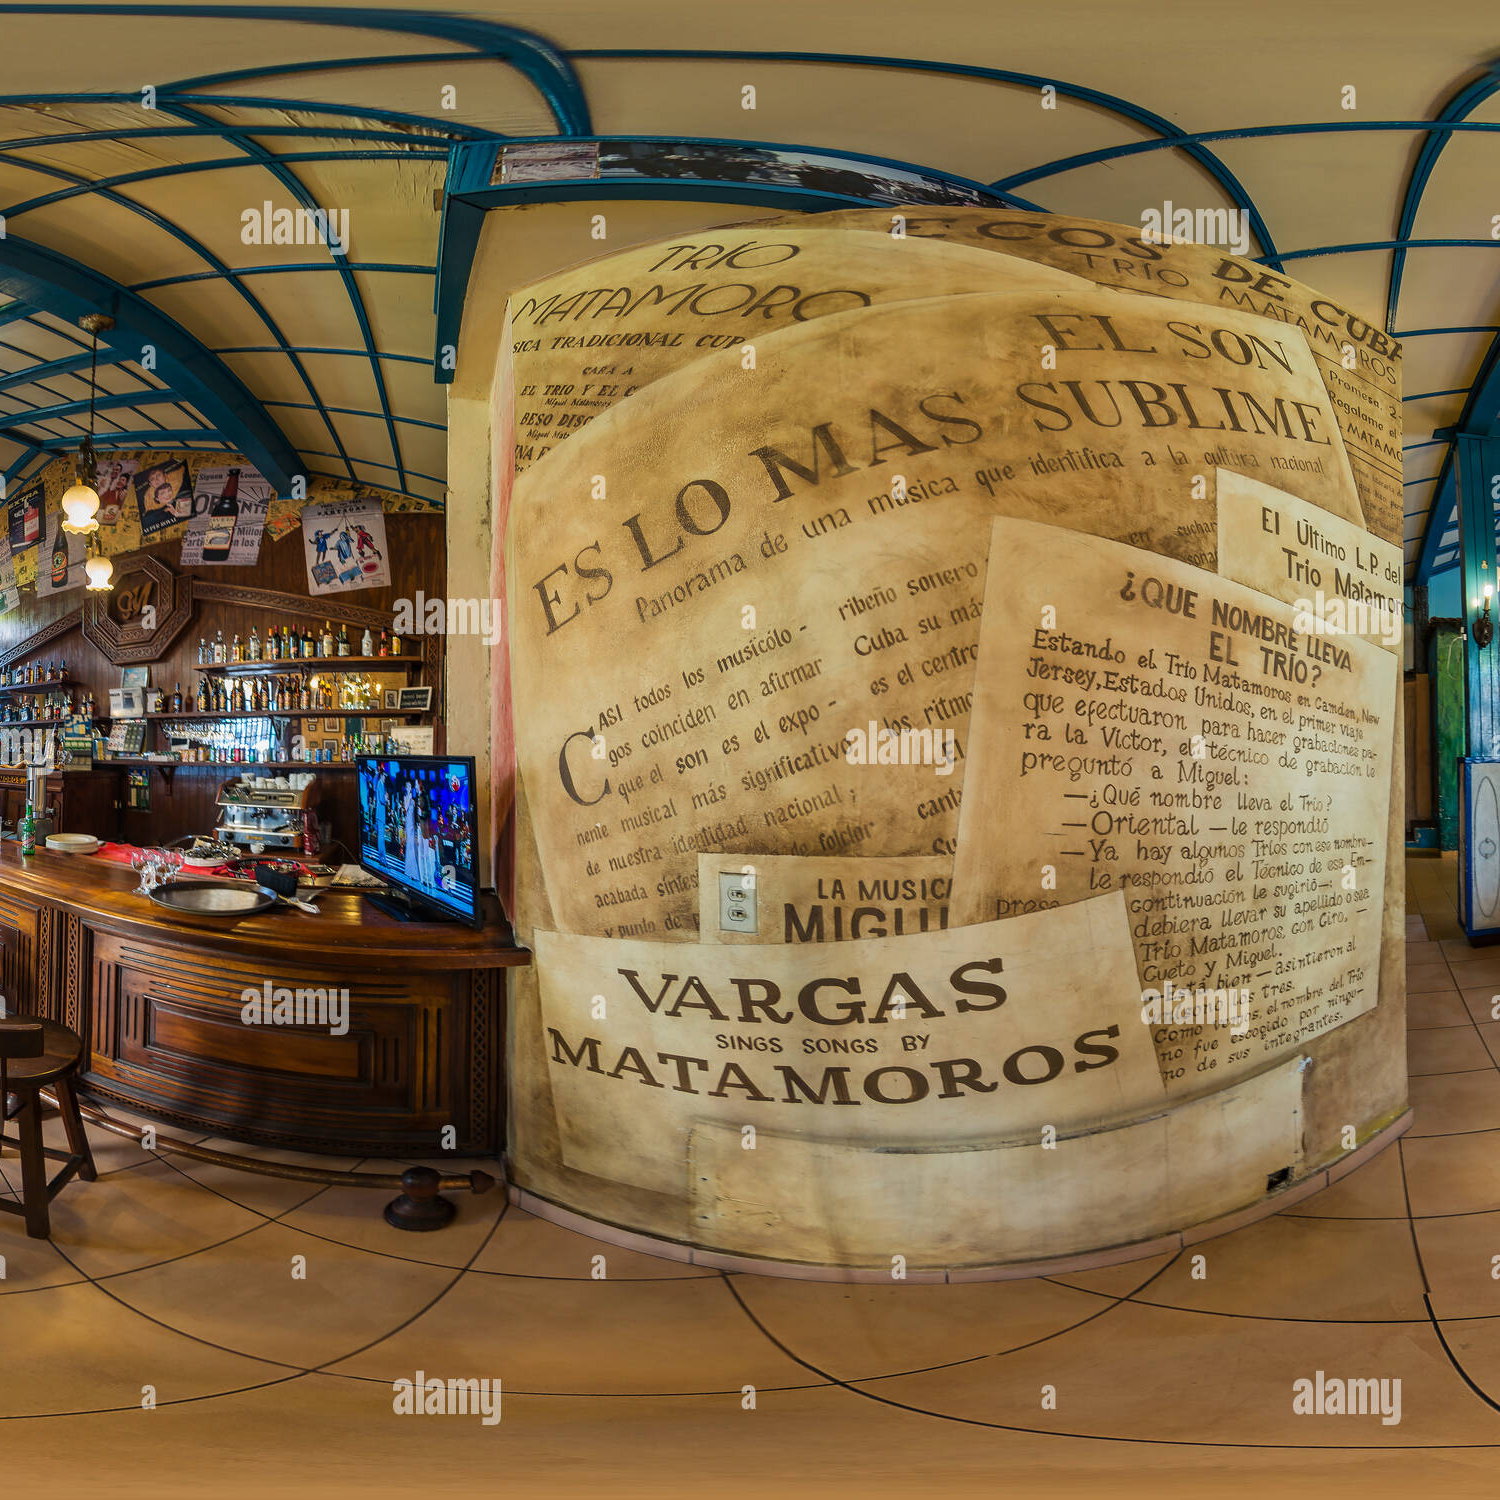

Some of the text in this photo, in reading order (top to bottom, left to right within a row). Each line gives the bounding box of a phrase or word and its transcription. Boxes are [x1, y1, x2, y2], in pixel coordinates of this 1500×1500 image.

[1211, 257, 1292, 302] DE
[550, 332, 685, 350] TRADICIONAL
[1029, 313, 1294, 375] EL SON
[1219, 286, 1397, 385] MATAMOROS
[520, 384, 618, 397] EL TRIO Y EL
[520, 412, 554, 427] BESO
[532, 380, 1332, 637] ES LO MAS SUBLIME
[634, 550, 748, 624] Panorama
[759, 531, 789, 560] de
[801, 506, 853, 539] una
[975, 463, 1016, 497] que
[1028, 446, 1125, 477] identifica
[1141, 450, 1157, 467] a
[1167, 445, 1190, 467] la
[1204, 445, 1261, 469] cultura
[1271, 455, 1326, 476] nacional
[1262, 506, 1401, 586] El Último L.P. del
[838, 562, 979, 621] ribeño sonero
[854, 627, 909, 657] Cuba
[1209, 630, 1322, 688] EL TRÍO?
[1212, 598, 1299, 652] NOMBRE
[1306, 634, 1352, 673] LLEVA
[634, 684, 672, 713] todos
[681, 667, 705, 689] los
[1032, 628, 1126, 664] Estando
[1137, 648, 1158, 670] el
[1203, 663, 1293, 704] Matamoros
[608, 658, 822, 767] gos coinciden en afirmar
[1023, 692, 1359, 758] que efectuaron para hacer grabaciones
[1102, 670, 1188, 703] Estados
[1194, 685, 1255, 719] Unidos,
[1297, 714, 1337, 733] primer
[1340, 723, 1364, 742] viaje
[618, 748, 708, 804] que son
[1020, 751, 1249, 791] preguntó Miguel:
[1065, 722, 1362, 777] la técnico grabación
[620, 798, 678, 833] musical
[691, 782, 727, 810] más
[741, 736, 854, 792] significativo
[1150, 788, 1273, 811] nombre lleva
[608, 814, 749, 872] nuestra identidad
[1136, 839, 1173, 866] hay
[1180, 840, 1246, 868] algunos
[1292, 842, 1313, 855] con
[1315, 841, 1331, 853] ese
[1255, 816, 1330, 841] respondió
[594, 885, 649, 909] acabada
[1119, 859, 1344, 890] respondió Técnico esa
[1131, 889, 1245, 914] continuación
[1134, 888, 1370, 939] debiera llevar apellido sea
[1143, 942, 1283, 982] Cueto Miguel.
[1216, 971, 1252, 991] bien
[618, 957, 1008, 1026] VARGAS
[1154, 1024, 1204, 1045] Como
[1280, 986, 1324, 1011] nombre
[1329, 973, 1345, 993] del
[715, 1033, 931, 1055] SINGS SONGS BY
[1193, 1004, 1320, 1060] fue escogido por
[1227, 1011, 1344, 1064] sus integrantes.
[547, 1024, 1121, 1106] MATAMOROS
